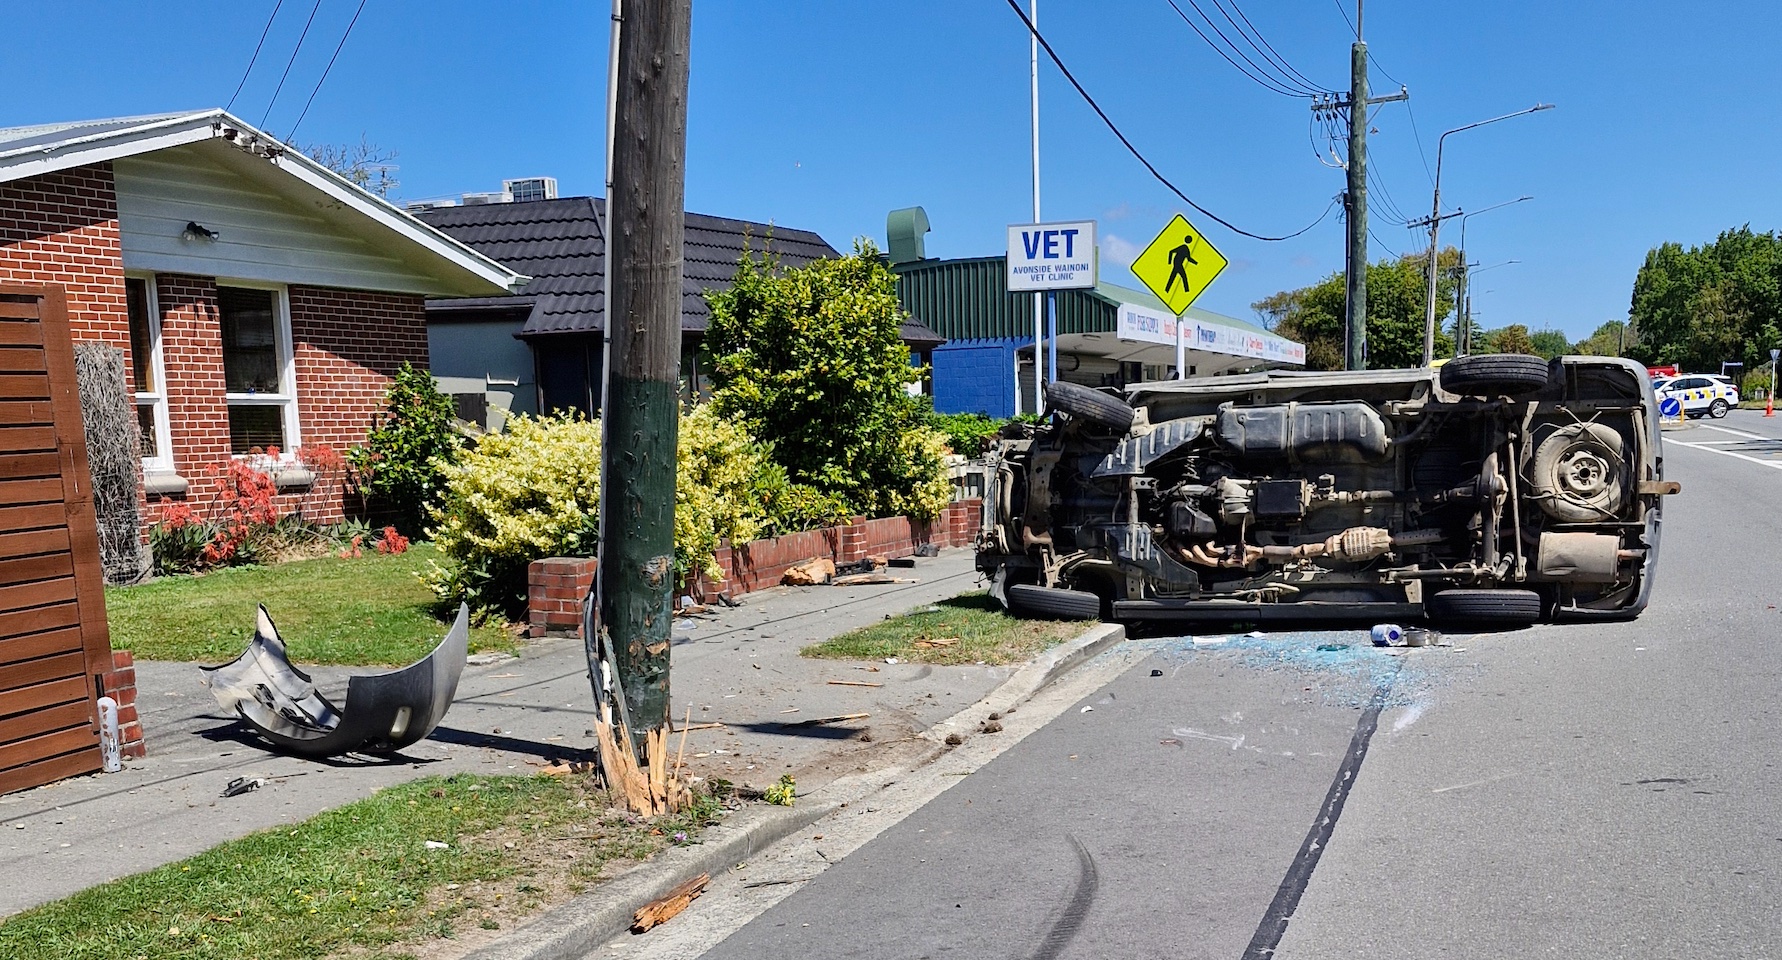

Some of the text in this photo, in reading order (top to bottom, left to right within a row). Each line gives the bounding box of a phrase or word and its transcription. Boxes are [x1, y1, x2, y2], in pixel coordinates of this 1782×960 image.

[1022, 229, 1079, 260] VET
[1013, 263, 1089, 275] AVONSIDE WAINONI
[1030, 272, 1074, 282] VET CLINIC
